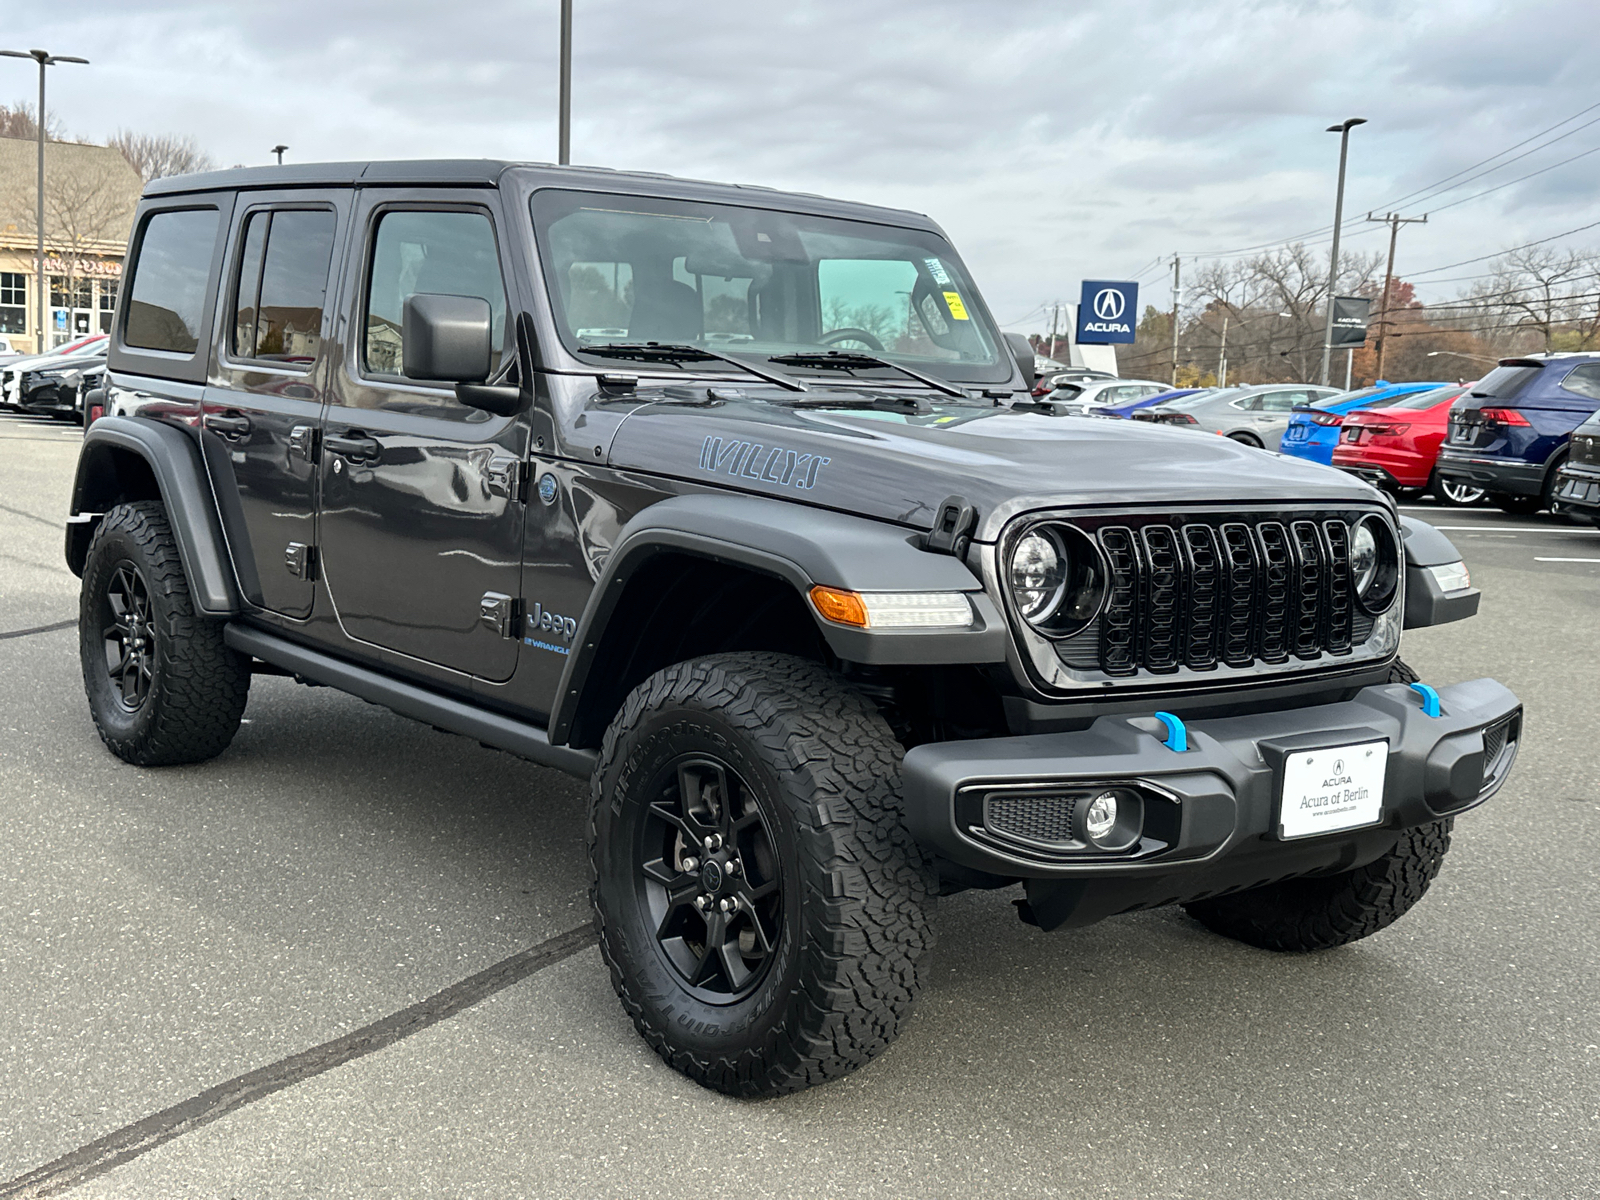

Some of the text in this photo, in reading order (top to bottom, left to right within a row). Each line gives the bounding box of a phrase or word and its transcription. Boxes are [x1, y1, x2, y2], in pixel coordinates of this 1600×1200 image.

[1084, 322, 1131, 333] ACURA
[699, 435, 832, 490] WILLYS
[527, 602, 577, 643] Jeep
[531, 638, 571, 656] WRANGLE
[611, 719, 745, 818] BFGoodrich
[1321, 775, 1353, 788] ACURA
[1299, 786, 1369, 810] Acura of Berlin
